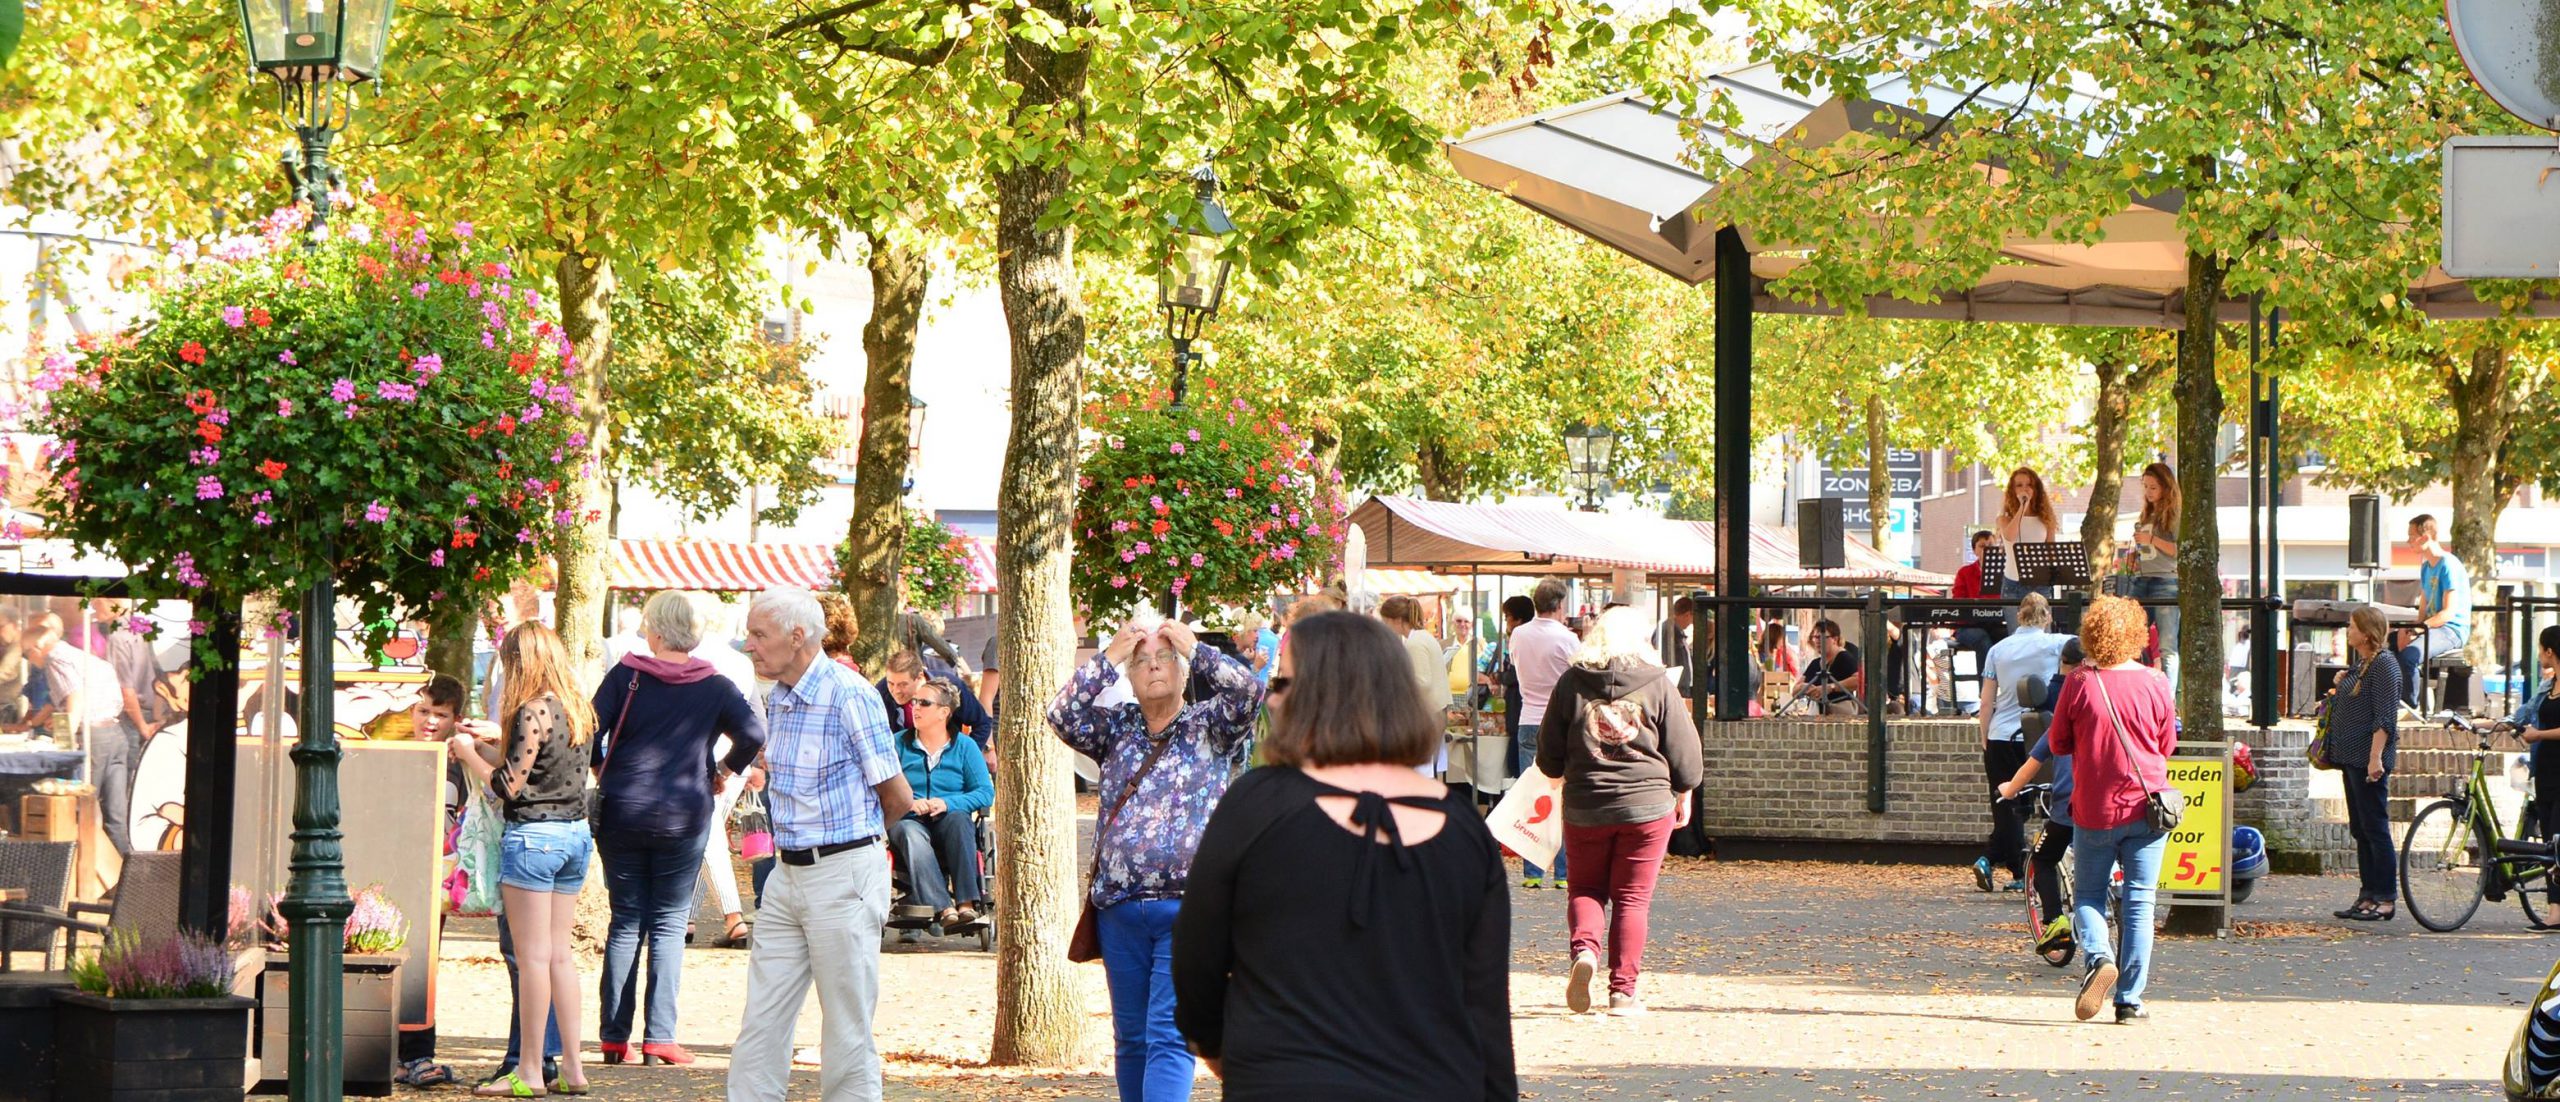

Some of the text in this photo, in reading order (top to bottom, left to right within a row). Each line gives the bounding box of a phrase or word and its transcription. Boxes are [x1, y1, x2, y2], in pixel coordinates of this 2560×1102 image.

[1824, 477, 1922, 492] ZONEBA
[1931, 608, 2003, 617] FP-4 Roland
